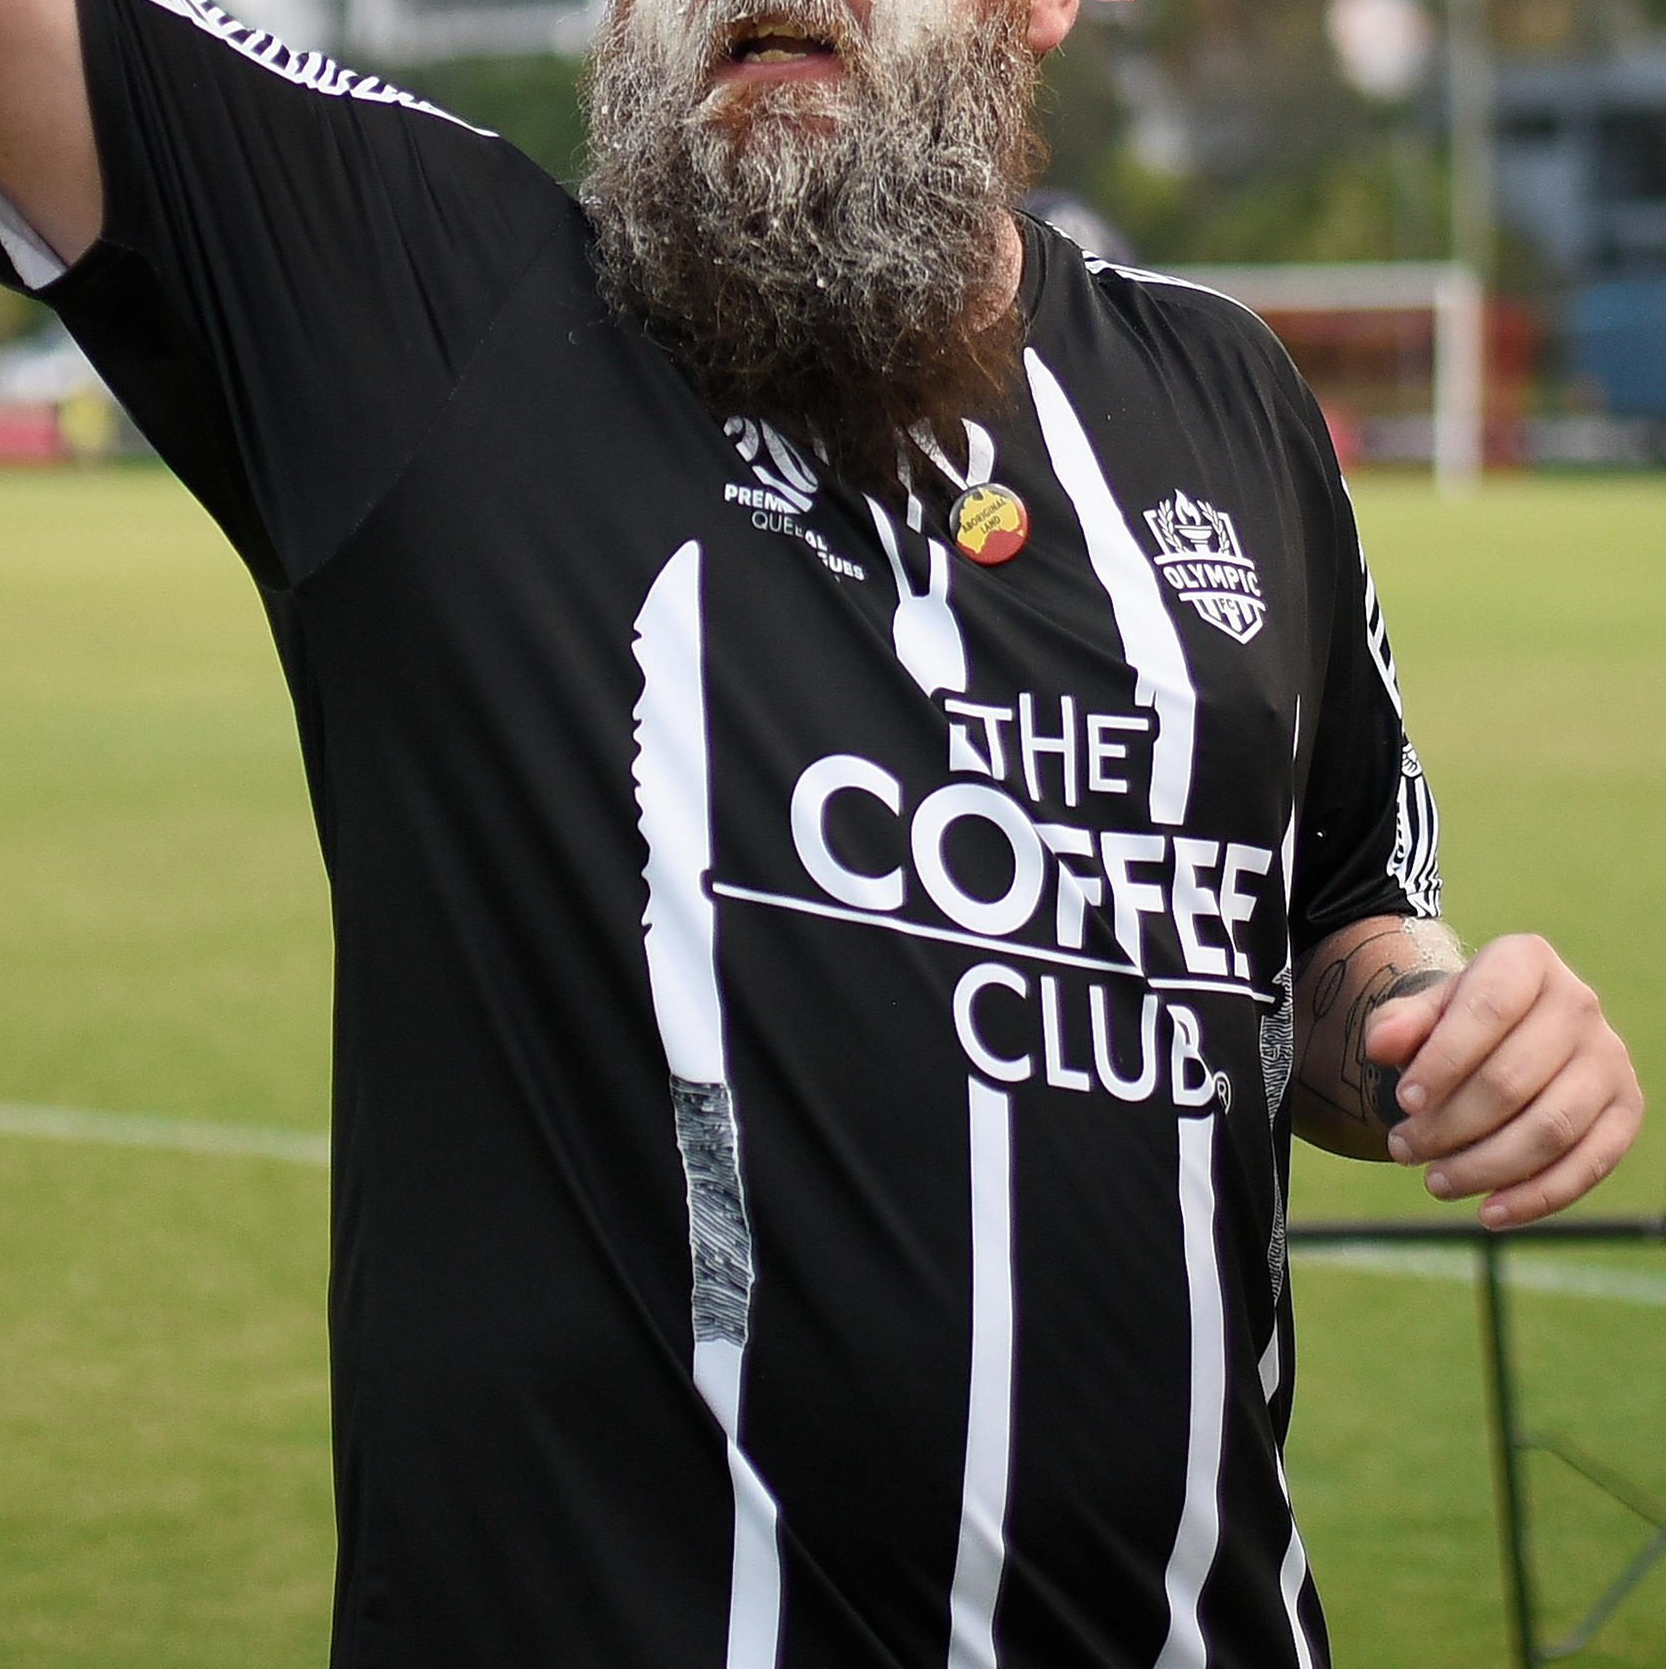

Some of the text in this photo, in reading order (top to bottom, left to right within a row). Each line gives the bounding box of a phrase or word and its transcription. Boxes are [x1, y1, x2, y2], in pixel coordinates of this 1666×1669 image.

[962, 498, 1006, 534] ABORIGINAL
[980, 516, 1001, 534] LAND
[1163, 563, 1261, 598] OLYMPIC
[1219, 598, 1235, 610] FC
[945, 693, 1149, 806] THE
[790, 755, 1272, 978] COFFEE
